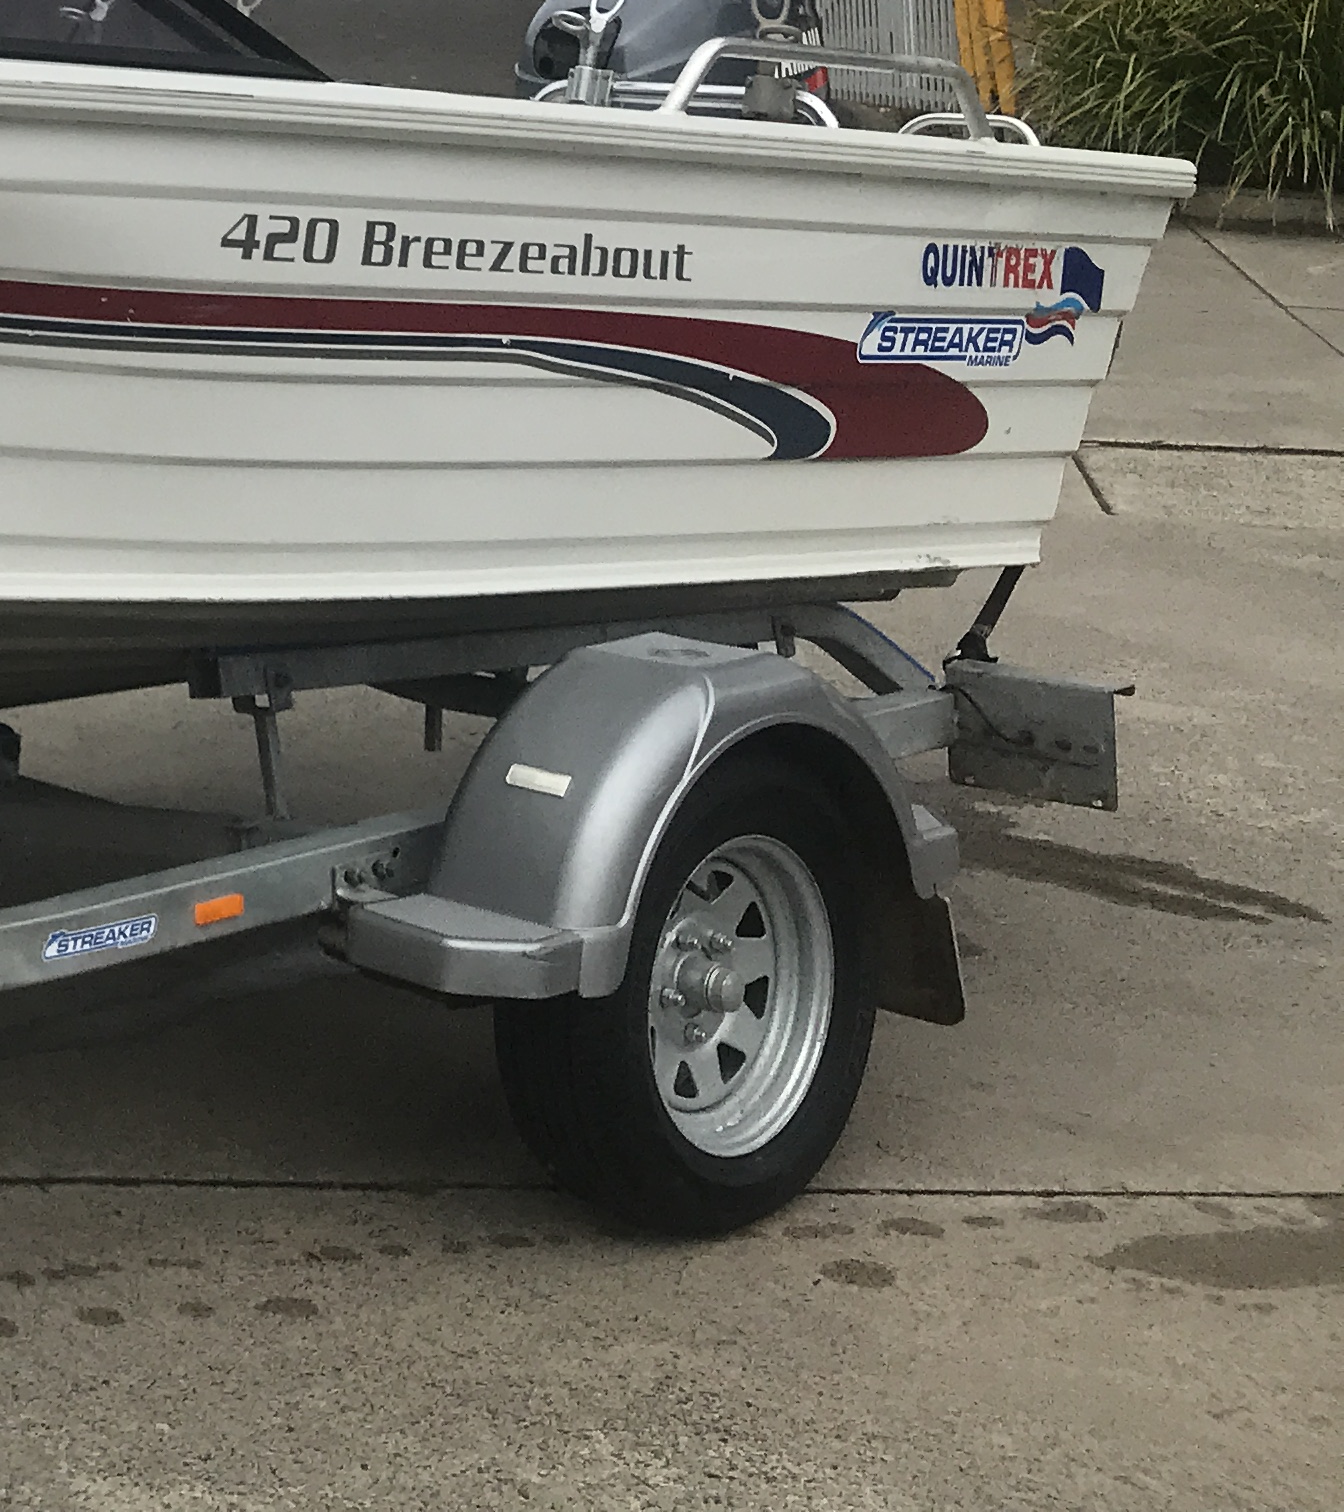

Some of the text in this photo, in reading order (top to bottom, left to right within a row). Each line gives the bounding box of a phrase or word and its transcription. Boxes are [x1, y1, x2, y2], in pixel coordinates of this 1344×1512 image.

[220, 213, 693, 282] 420 Breezeabout
[922, 242, 1056, 290] QUINTREX
[877, 325, 1017, 354] STREAKER
[966, 354, 1011, 368] MARINE
[56, 919, 153, 954] STREAKER
